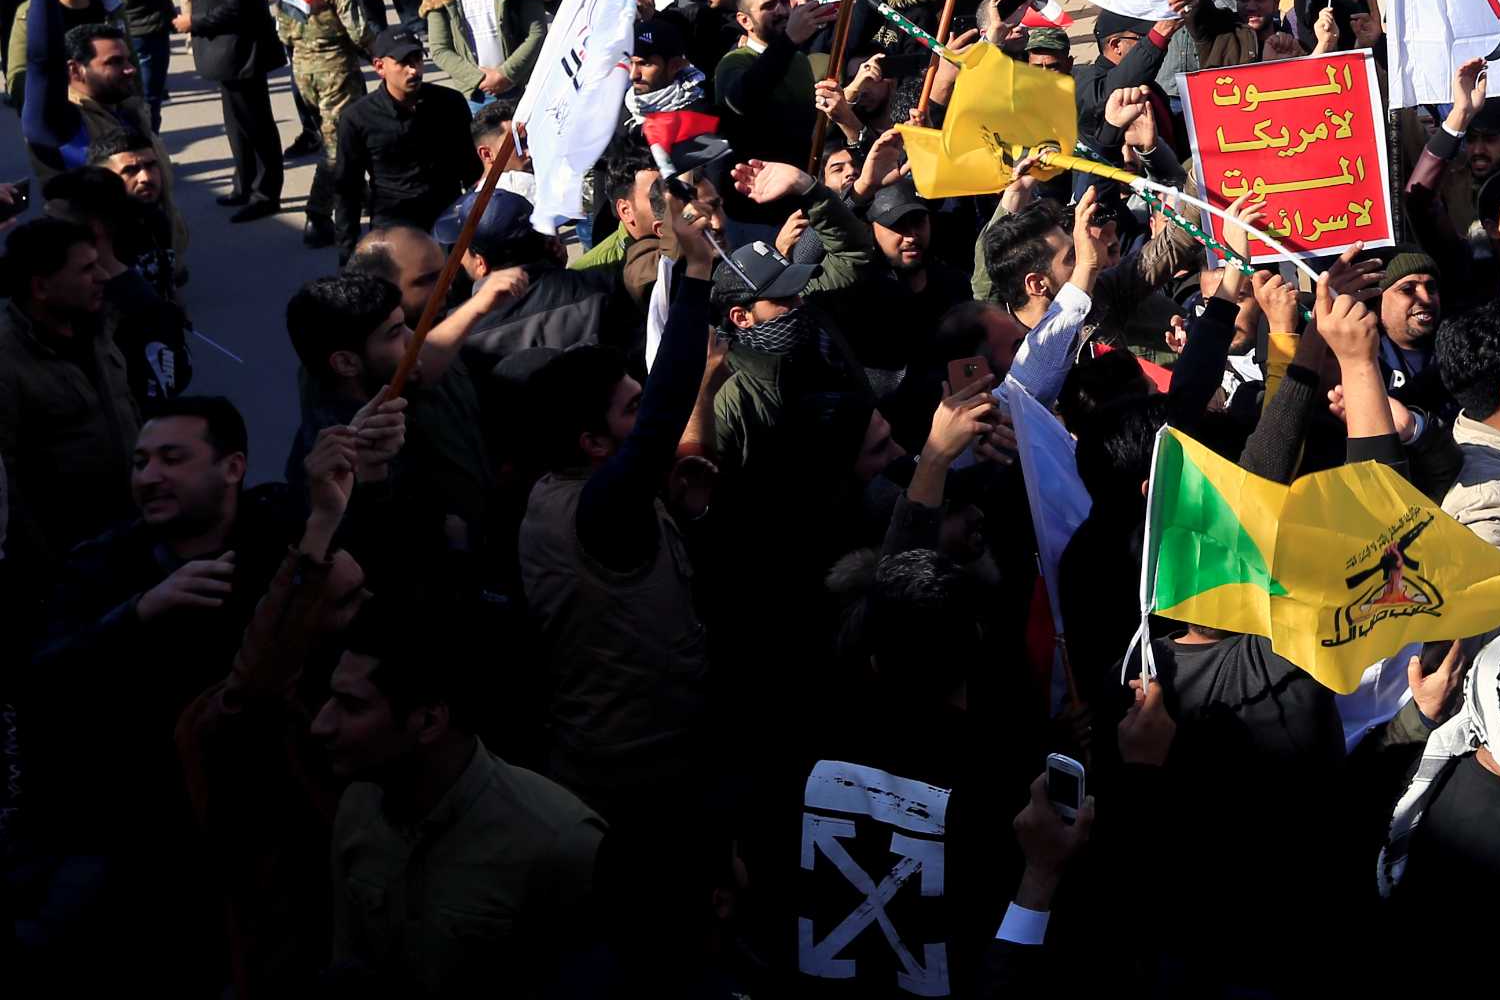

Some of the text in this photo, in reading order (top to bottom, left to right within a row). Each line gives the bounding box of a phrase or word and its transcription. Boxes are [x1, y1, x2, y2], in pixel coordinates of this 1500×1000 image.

[1212, 63, 1353, 112] الموت
[1215, 107, 1355, 158] لأمريكا
[1220, 155, 1366, 204] الموت
[1246, 198, 1374, 247] لاسرائي
